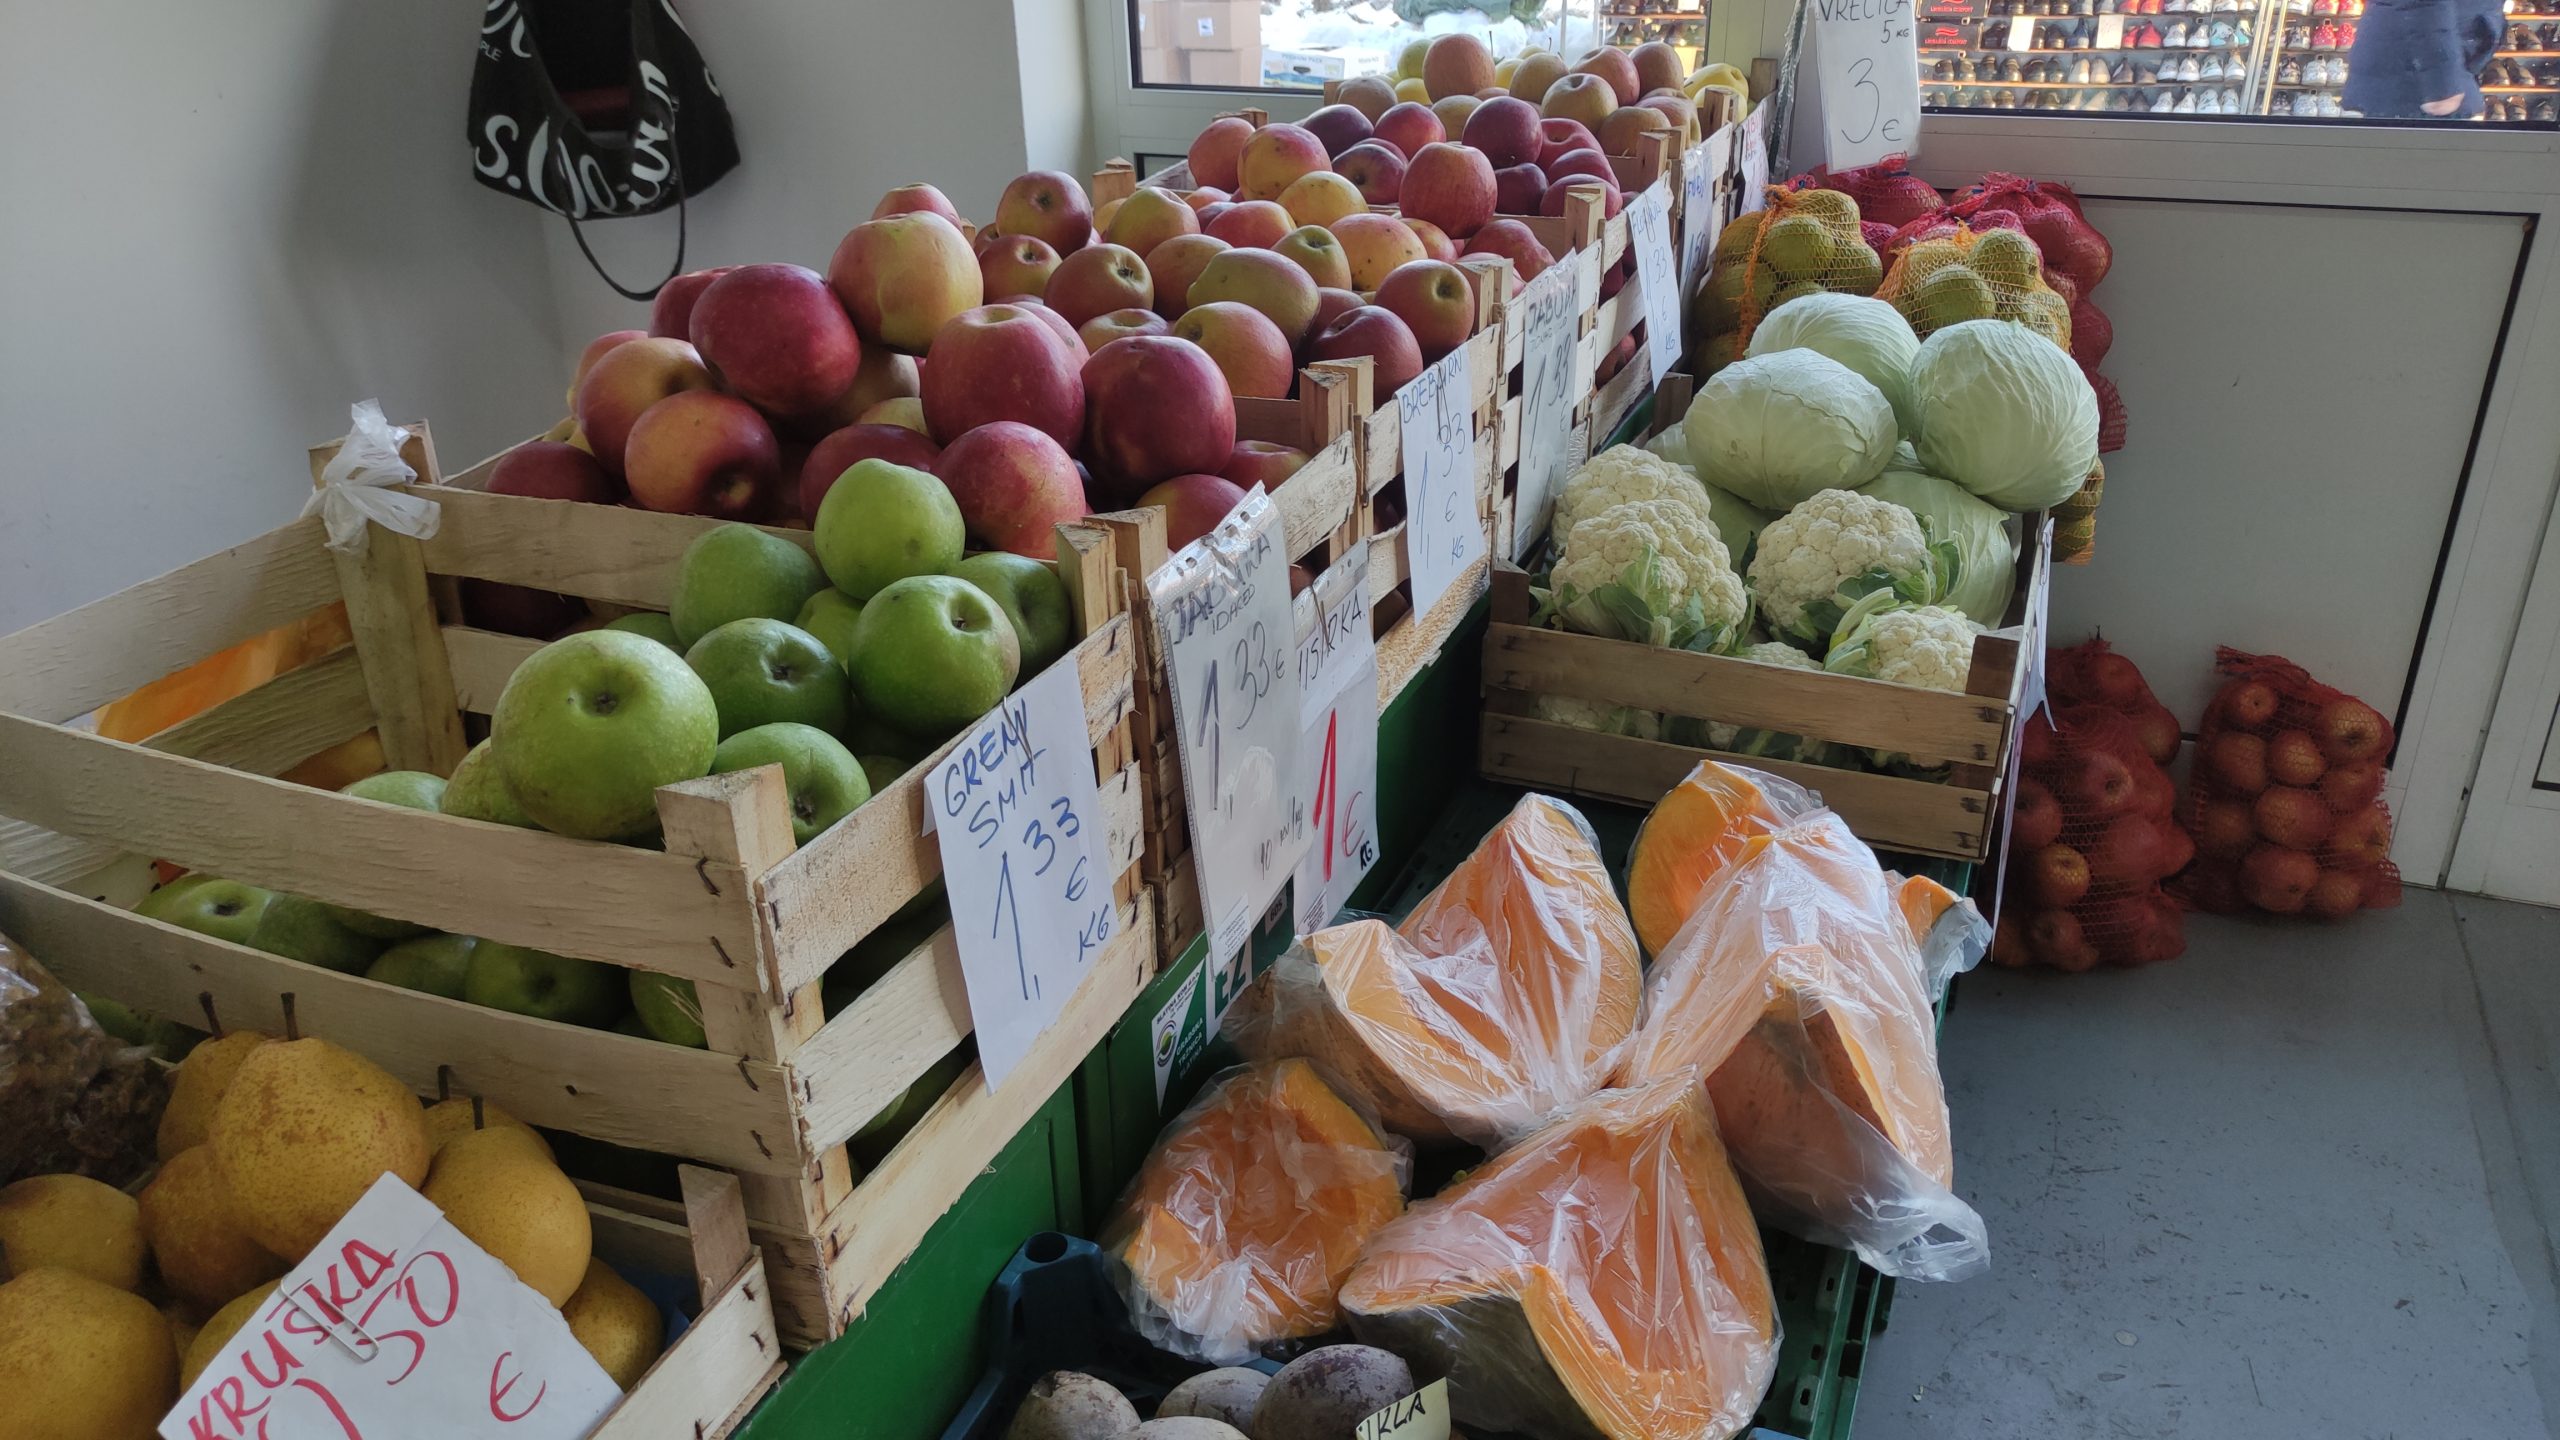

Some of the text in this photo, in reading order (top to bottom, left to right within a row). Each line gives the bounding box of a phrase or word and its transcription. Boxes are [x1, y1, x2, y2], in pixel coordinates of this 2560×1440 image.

[1881, 19, 1895, 44] 5
[1841, 58, 1902, 144] 3 €
[1451, 534, 1465, 567] KG
[1313, 707, 1338, 882] 1
[1342, 790, 1365, 858] €
[1065, 855, 1089, 902] €
[1360, 839, 1374, 872] KG
[1077, 903, 1110, 963] KG
[488, 1351, 547, 1423] €
